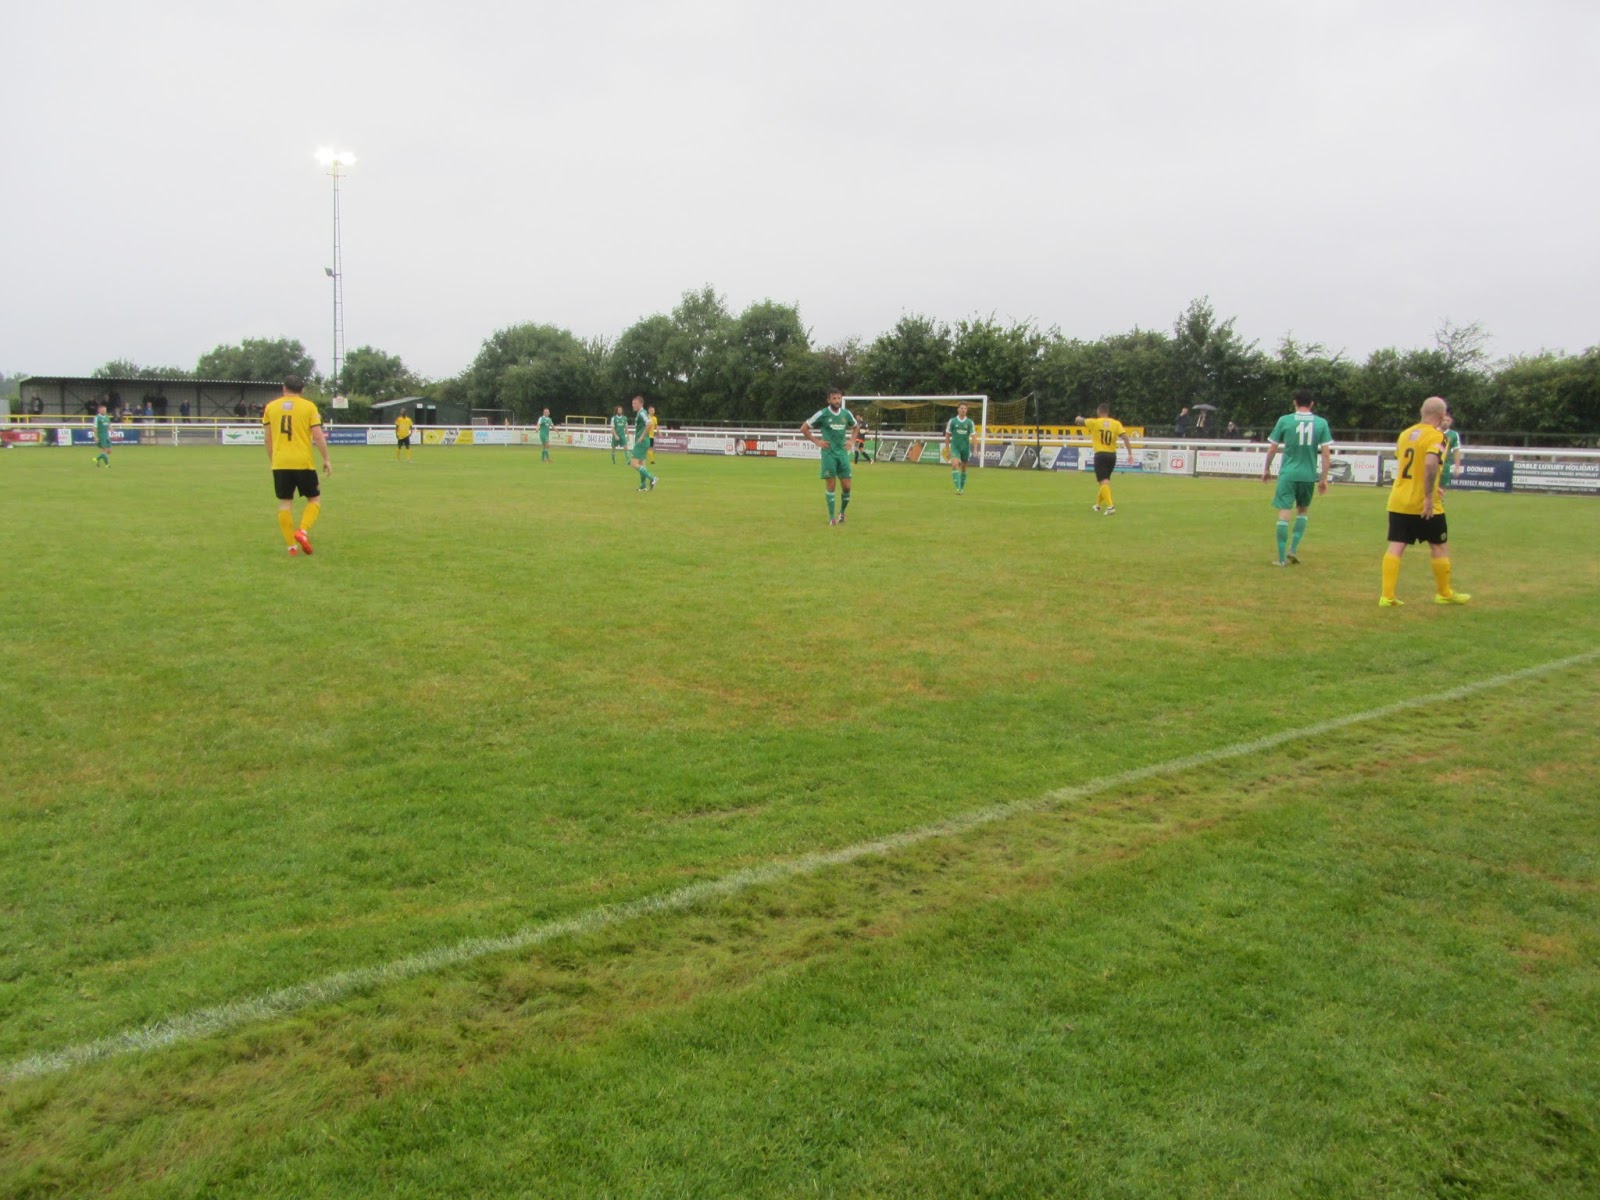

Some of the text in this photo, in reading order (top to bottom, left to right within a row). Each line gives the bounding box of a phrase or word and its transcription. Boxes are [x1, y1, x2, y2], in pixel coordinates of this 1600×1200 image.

[281, 415, 293, 442] 4
[1099, 429, 1113, 446] 10
[1295, 421, 1315, 446] 11
[1402, 447, 1416, 479] 2
[1565, 464, 1600, 472] HOLIDAYS
